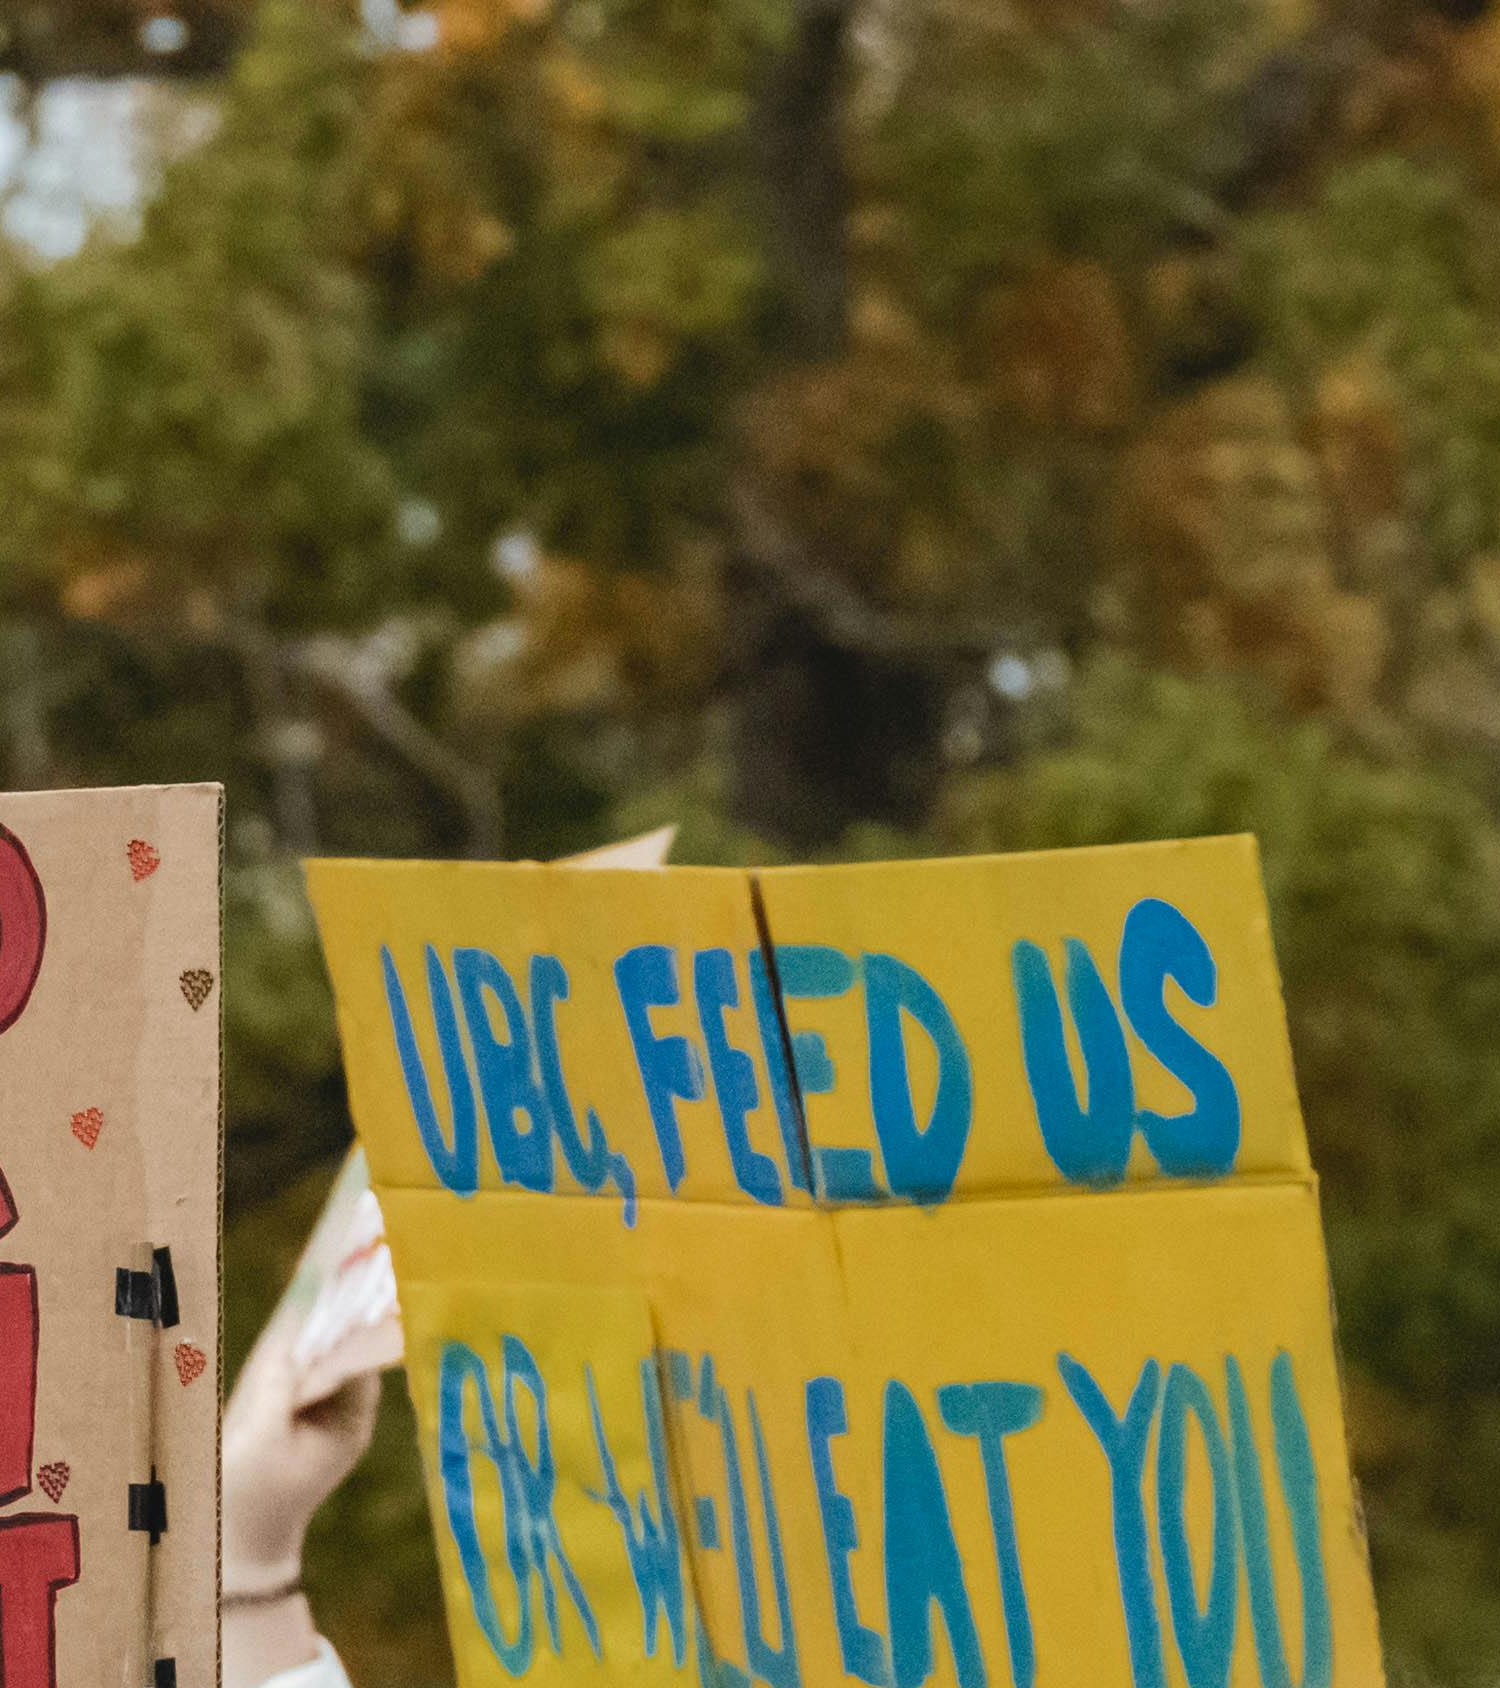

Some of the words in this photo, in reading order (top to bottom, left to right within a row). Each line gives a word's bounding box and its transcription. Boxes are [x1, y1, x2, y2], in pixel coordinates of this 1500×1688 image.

[378, 940, 639, 1230] UBC,
[612, 942, 974, 1212] FEED
[1011, 896, 1243, 1190] US
[439, 1332, 604, 1680] OR
